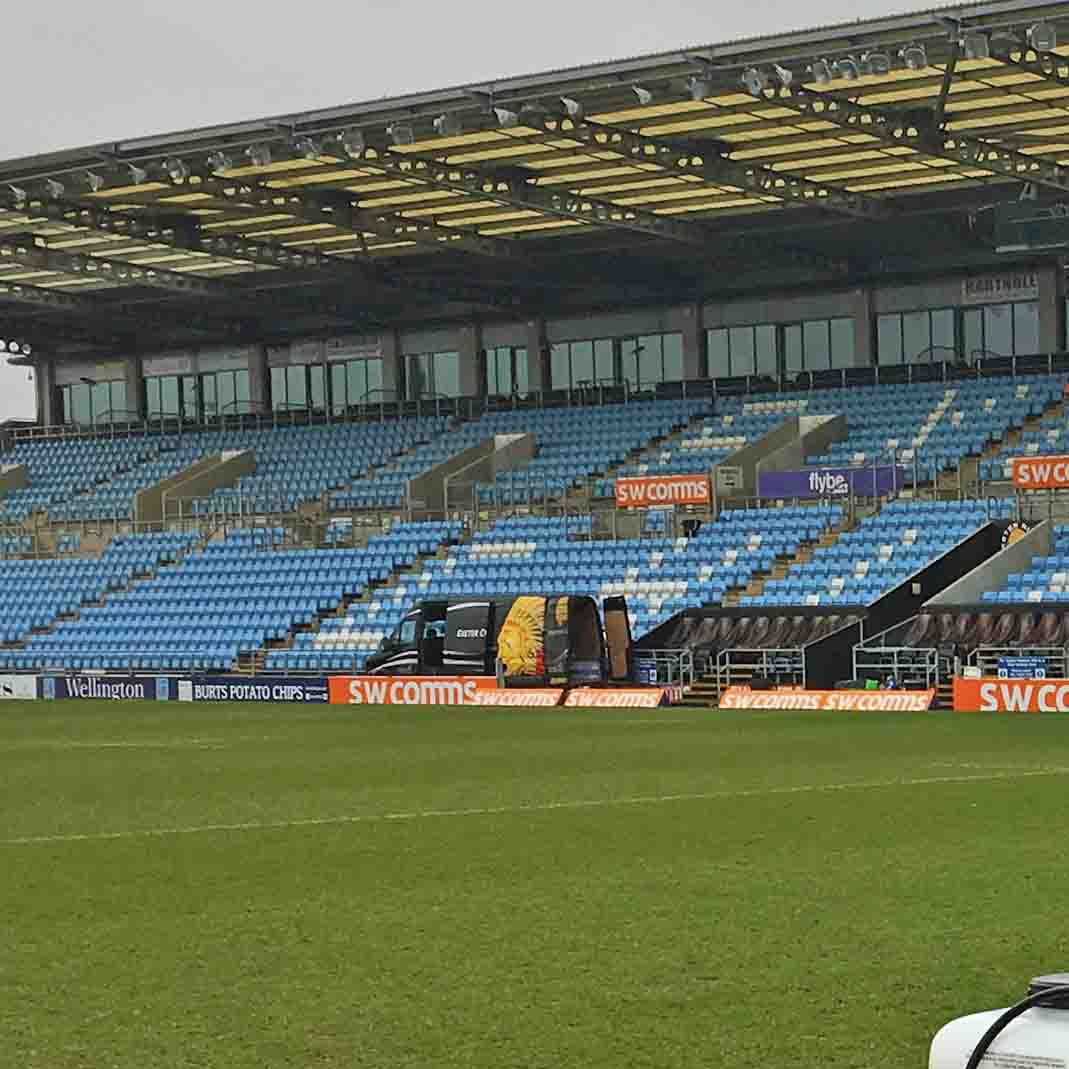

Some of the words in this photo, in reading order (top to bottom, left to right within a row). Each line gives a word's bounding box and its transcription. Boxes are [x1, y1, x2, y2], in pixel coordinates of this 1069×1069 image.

[65, 677, 145, 700] Wellington
[195, 685, 228, 700] BURTS
[230, 685, 270, 700] POTATO
[273, 685, 304, 700] CHIPS
